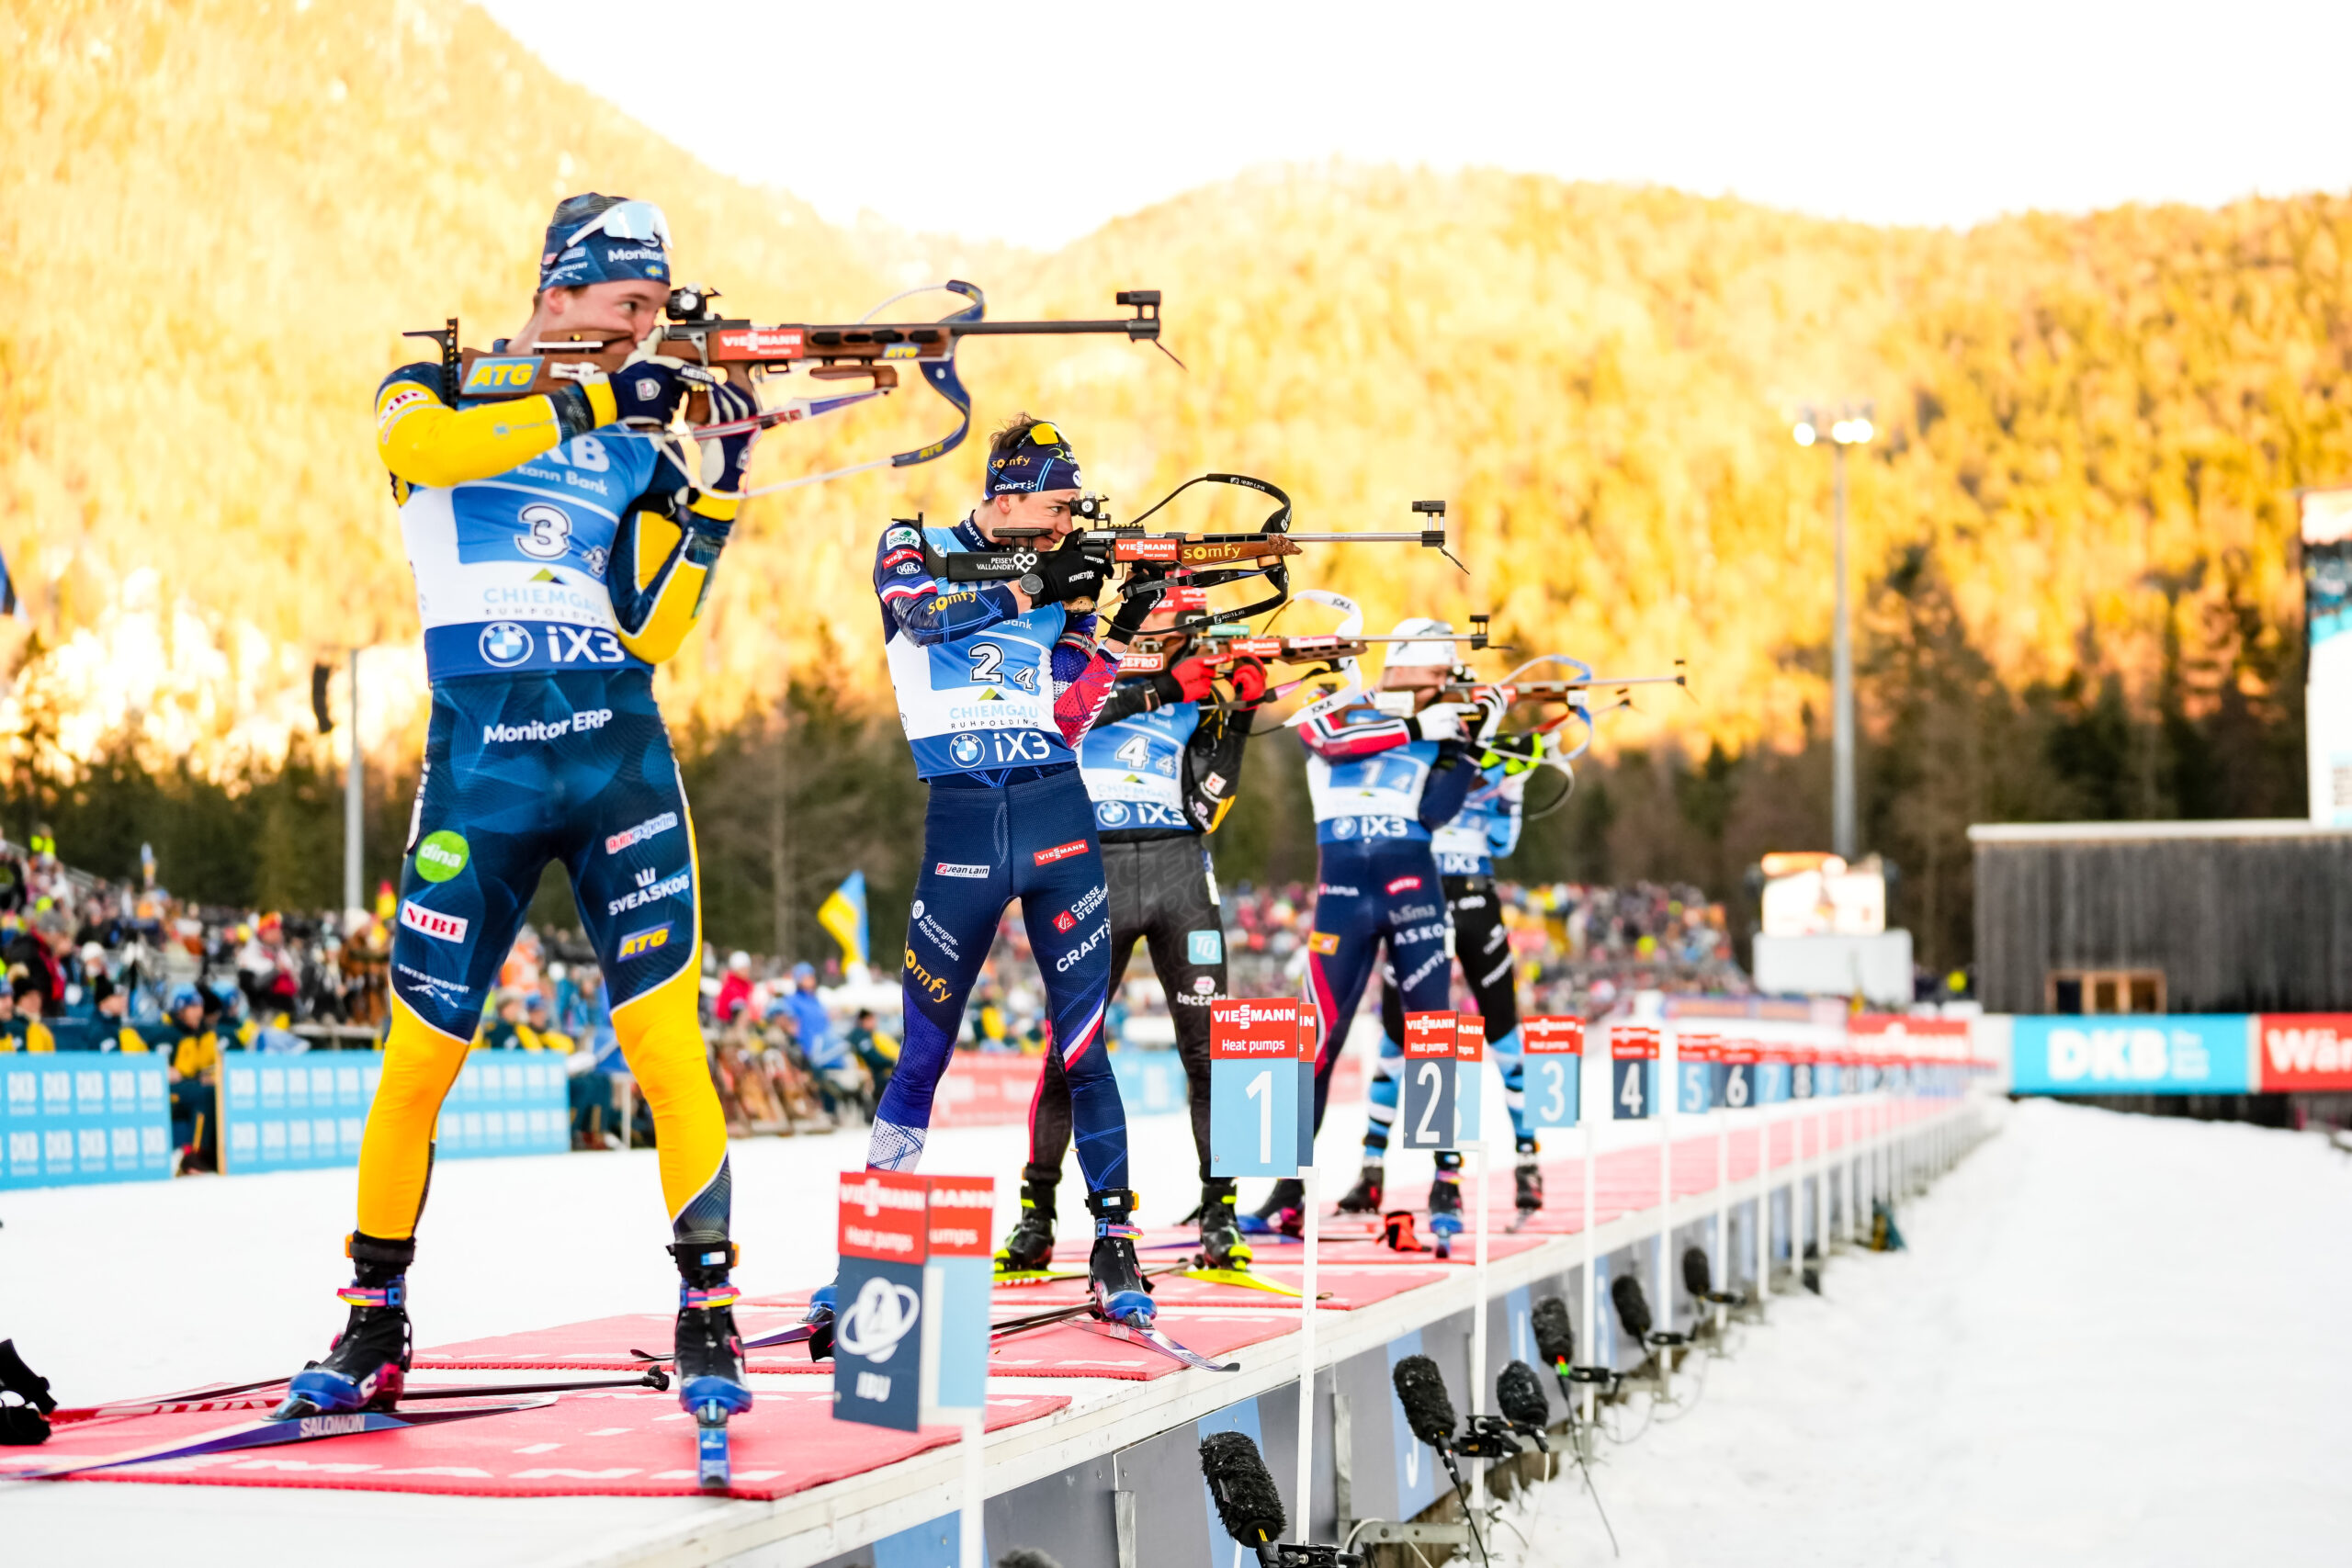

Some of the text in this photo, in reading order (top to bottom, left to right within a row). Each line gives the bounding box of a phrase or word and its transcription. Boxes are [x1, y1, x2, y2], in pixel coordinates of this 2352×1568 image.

[721, 332, 801, 351] VIESSMANN
[887, 346, 918, 358] ATG
[470, 364, 534, 387] ATG
[920, 443, 944, 458] ATG
[516, 466, 608, 497] kann Bank
[995, 482, 1027, 491] CRAFT
[514, 502, 572, 560] 3
[964, 519, 980, 541] CRAFT
[1118, 541, 1176, 554] VIESSMANN
[1183, 543, 1241, 560] somfy
[928, 592, 977, 615] somfy
[546, 625, 625, 662] iX3
[968, 642, 1004, 684] 2
[1014, 667, 1037, 692] 4
[949, 704, 1038, 719] CHIEMGAU
[951, 717, 1039, 729] RUHPOLDING
[483, 708, 613, 744] Monitor ERP
[993, 732, 1051, 762] iX3
[1114, 734, 1151, 770] 4
[1156, 755, 1175, 775] 4
[1360, 758, 1387, 787] 1
[1390, 773, 1414, 792] 4
[1136, 803, 1189, 826] iX3
[1360, 816, 1408, 837] iX3
[420, 841, 462, 869] dina
[1037, 842, 1085, 861] VIESSMANN
[946, 865, 988, 874] Jean Lain
[608, 874, 690, 916] SVEASKOG
[1070, 885, 1101, 913] CAISSE
[1076, 883, 1109, 921] D'EPARGN
[406, 907, 465, 938] NIBE
[923, 913, 958, 946] Auvergne-
[1394, 923, 1446, 946] ASKO
[619, 928, 669, 958] ATG
[918, 919, 959, 962] Rhône-Alpes
[1057, 923, 1106, 973] CRAFT
[1194, 935, 1217, 960] TQ
[1213, 1004, 1296, 1030] VIESSMANN
[1406, 1015, 1456, 1035] VIESSMANN
[1222, 1039, 1285, 1054] Heat pumps
[1410, 1043, 1449, 1054] Heat pumps
[2048, 1029, 2169, 1081] DKB
[1540, 1060, 1566, 1122] 3
[1620, 1062, 1644, 1117] 4
[1685, 1065, 1704, 1112] 5
[1726, 1064, 1748, 1108] 6
[1416, 1062, 1442, 1145] 2
[1246, 1070, 1272, 1164] 1
[929, 1228, 978, 1247] umps
[300, 1413, 366, 1438] SALOMON
